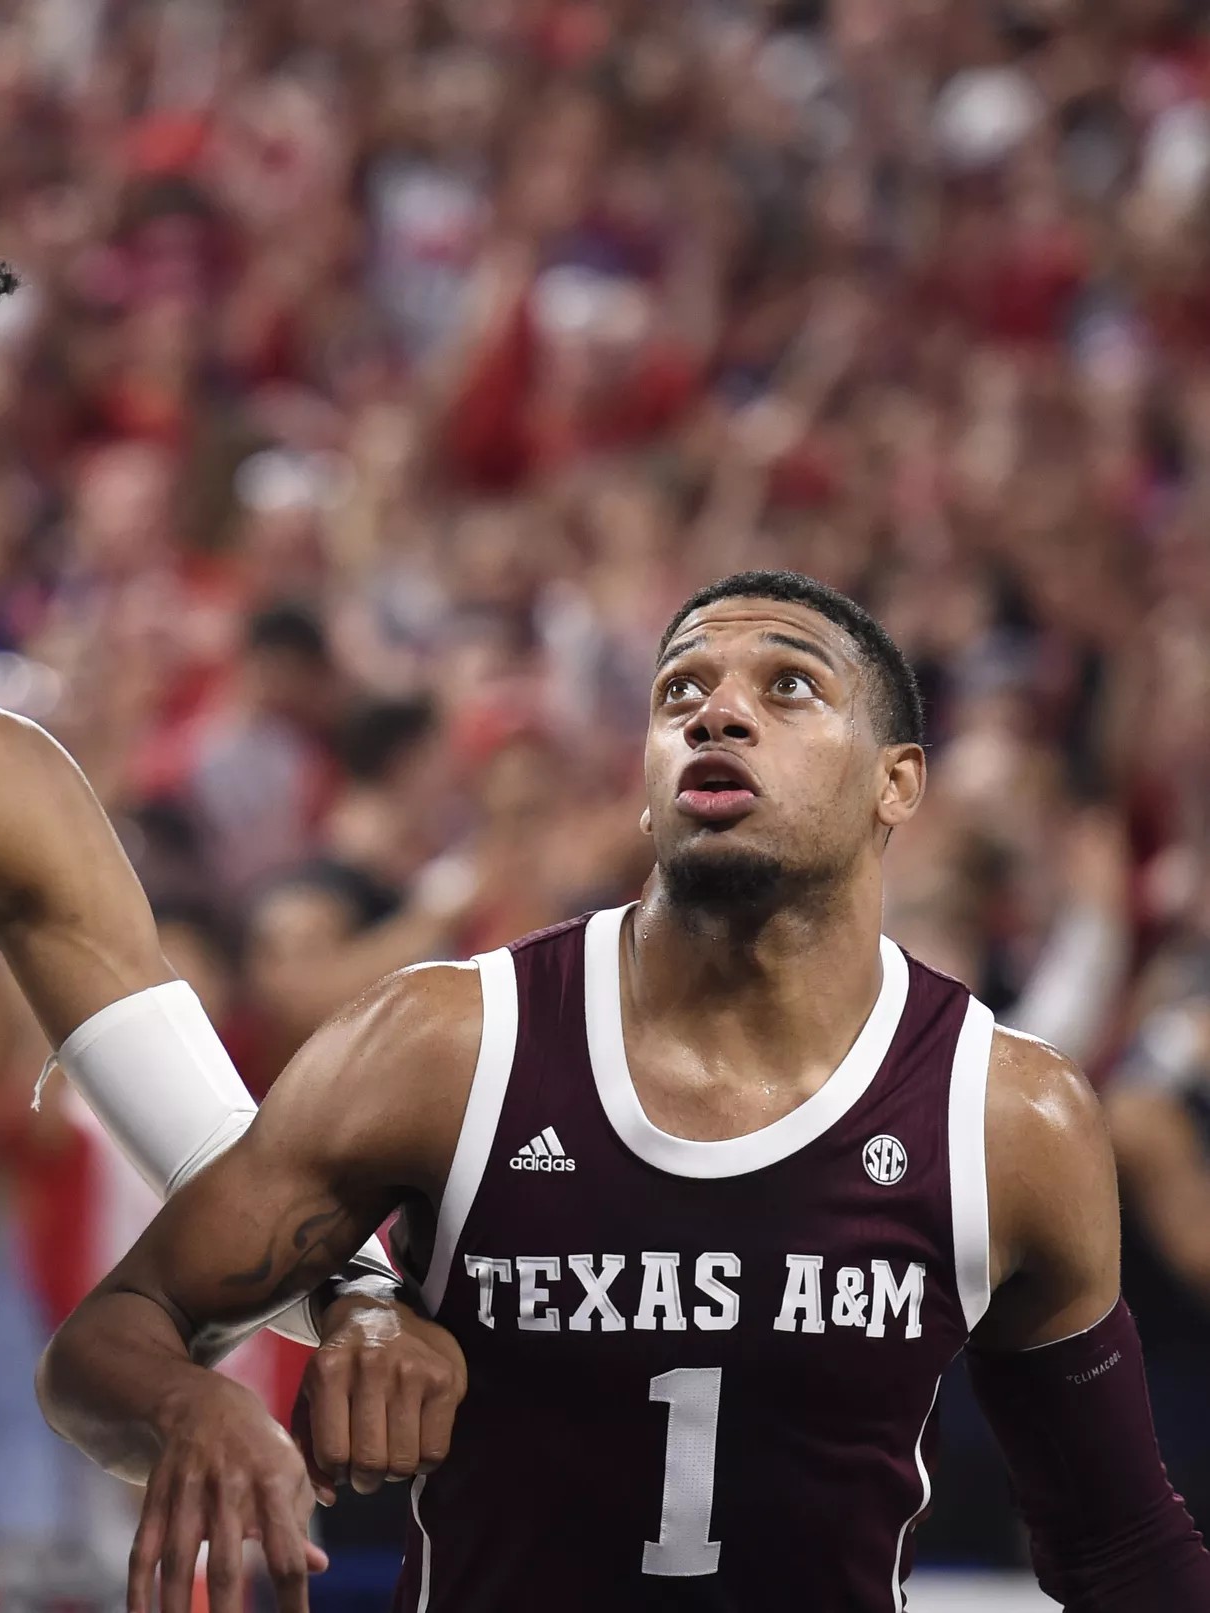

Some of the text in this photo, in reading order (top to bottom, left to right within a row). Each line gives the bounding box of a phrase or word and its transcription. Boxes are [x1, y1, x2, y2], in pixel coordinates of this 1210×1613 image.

[509, 1153, 576, 1172] adidas
[868, 1139, 905, 1182] SEC
[464, 1251, 926, 1340] TEXAS A&M
[1073, 1349, 1122, 1385] CLIMACOOL
[641, 1366, 722, 1577] 1
